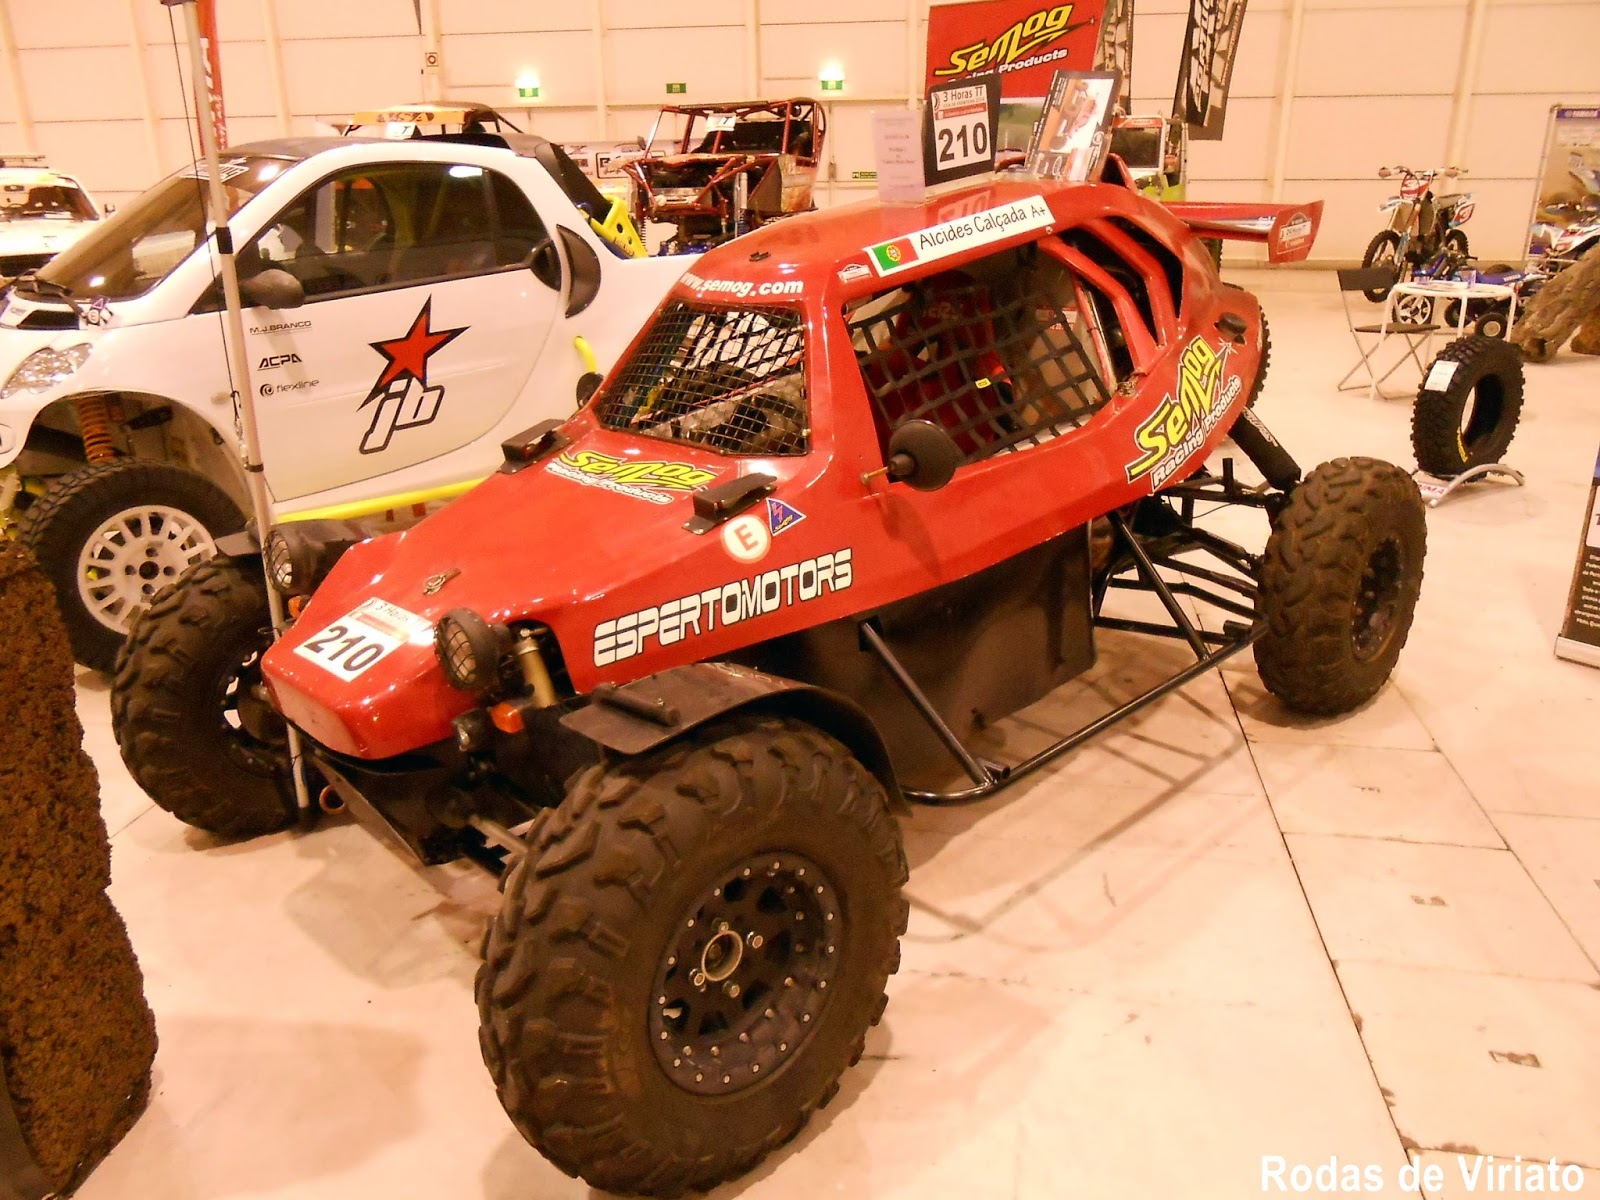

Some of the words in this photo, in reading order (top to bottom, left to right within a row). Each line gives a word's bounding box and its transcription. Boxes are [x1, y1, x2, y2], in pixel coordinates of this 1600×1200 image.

[999, 48, 1068, 74] Products
[943, 91, 949, 102] 3
[950, 89, 973, 101] Horas
[975, 86, 984, 97] TT
[938, 122, 988, 162] 210
[920, 222, 973, 250] Alcides
[973, 206, 1028, 232] Calçada
[1031, 204, 1046, 219] A+
[1153, 430, 1204, 487] Racing
[1203, 376, 1241, 431] Products
[599, 478, 674, 504] Products
[733, 523, 760, 552] E
[593, 547, 853, 668] ESPERTOMOTORS
[303, 625, 385, 672] 210
